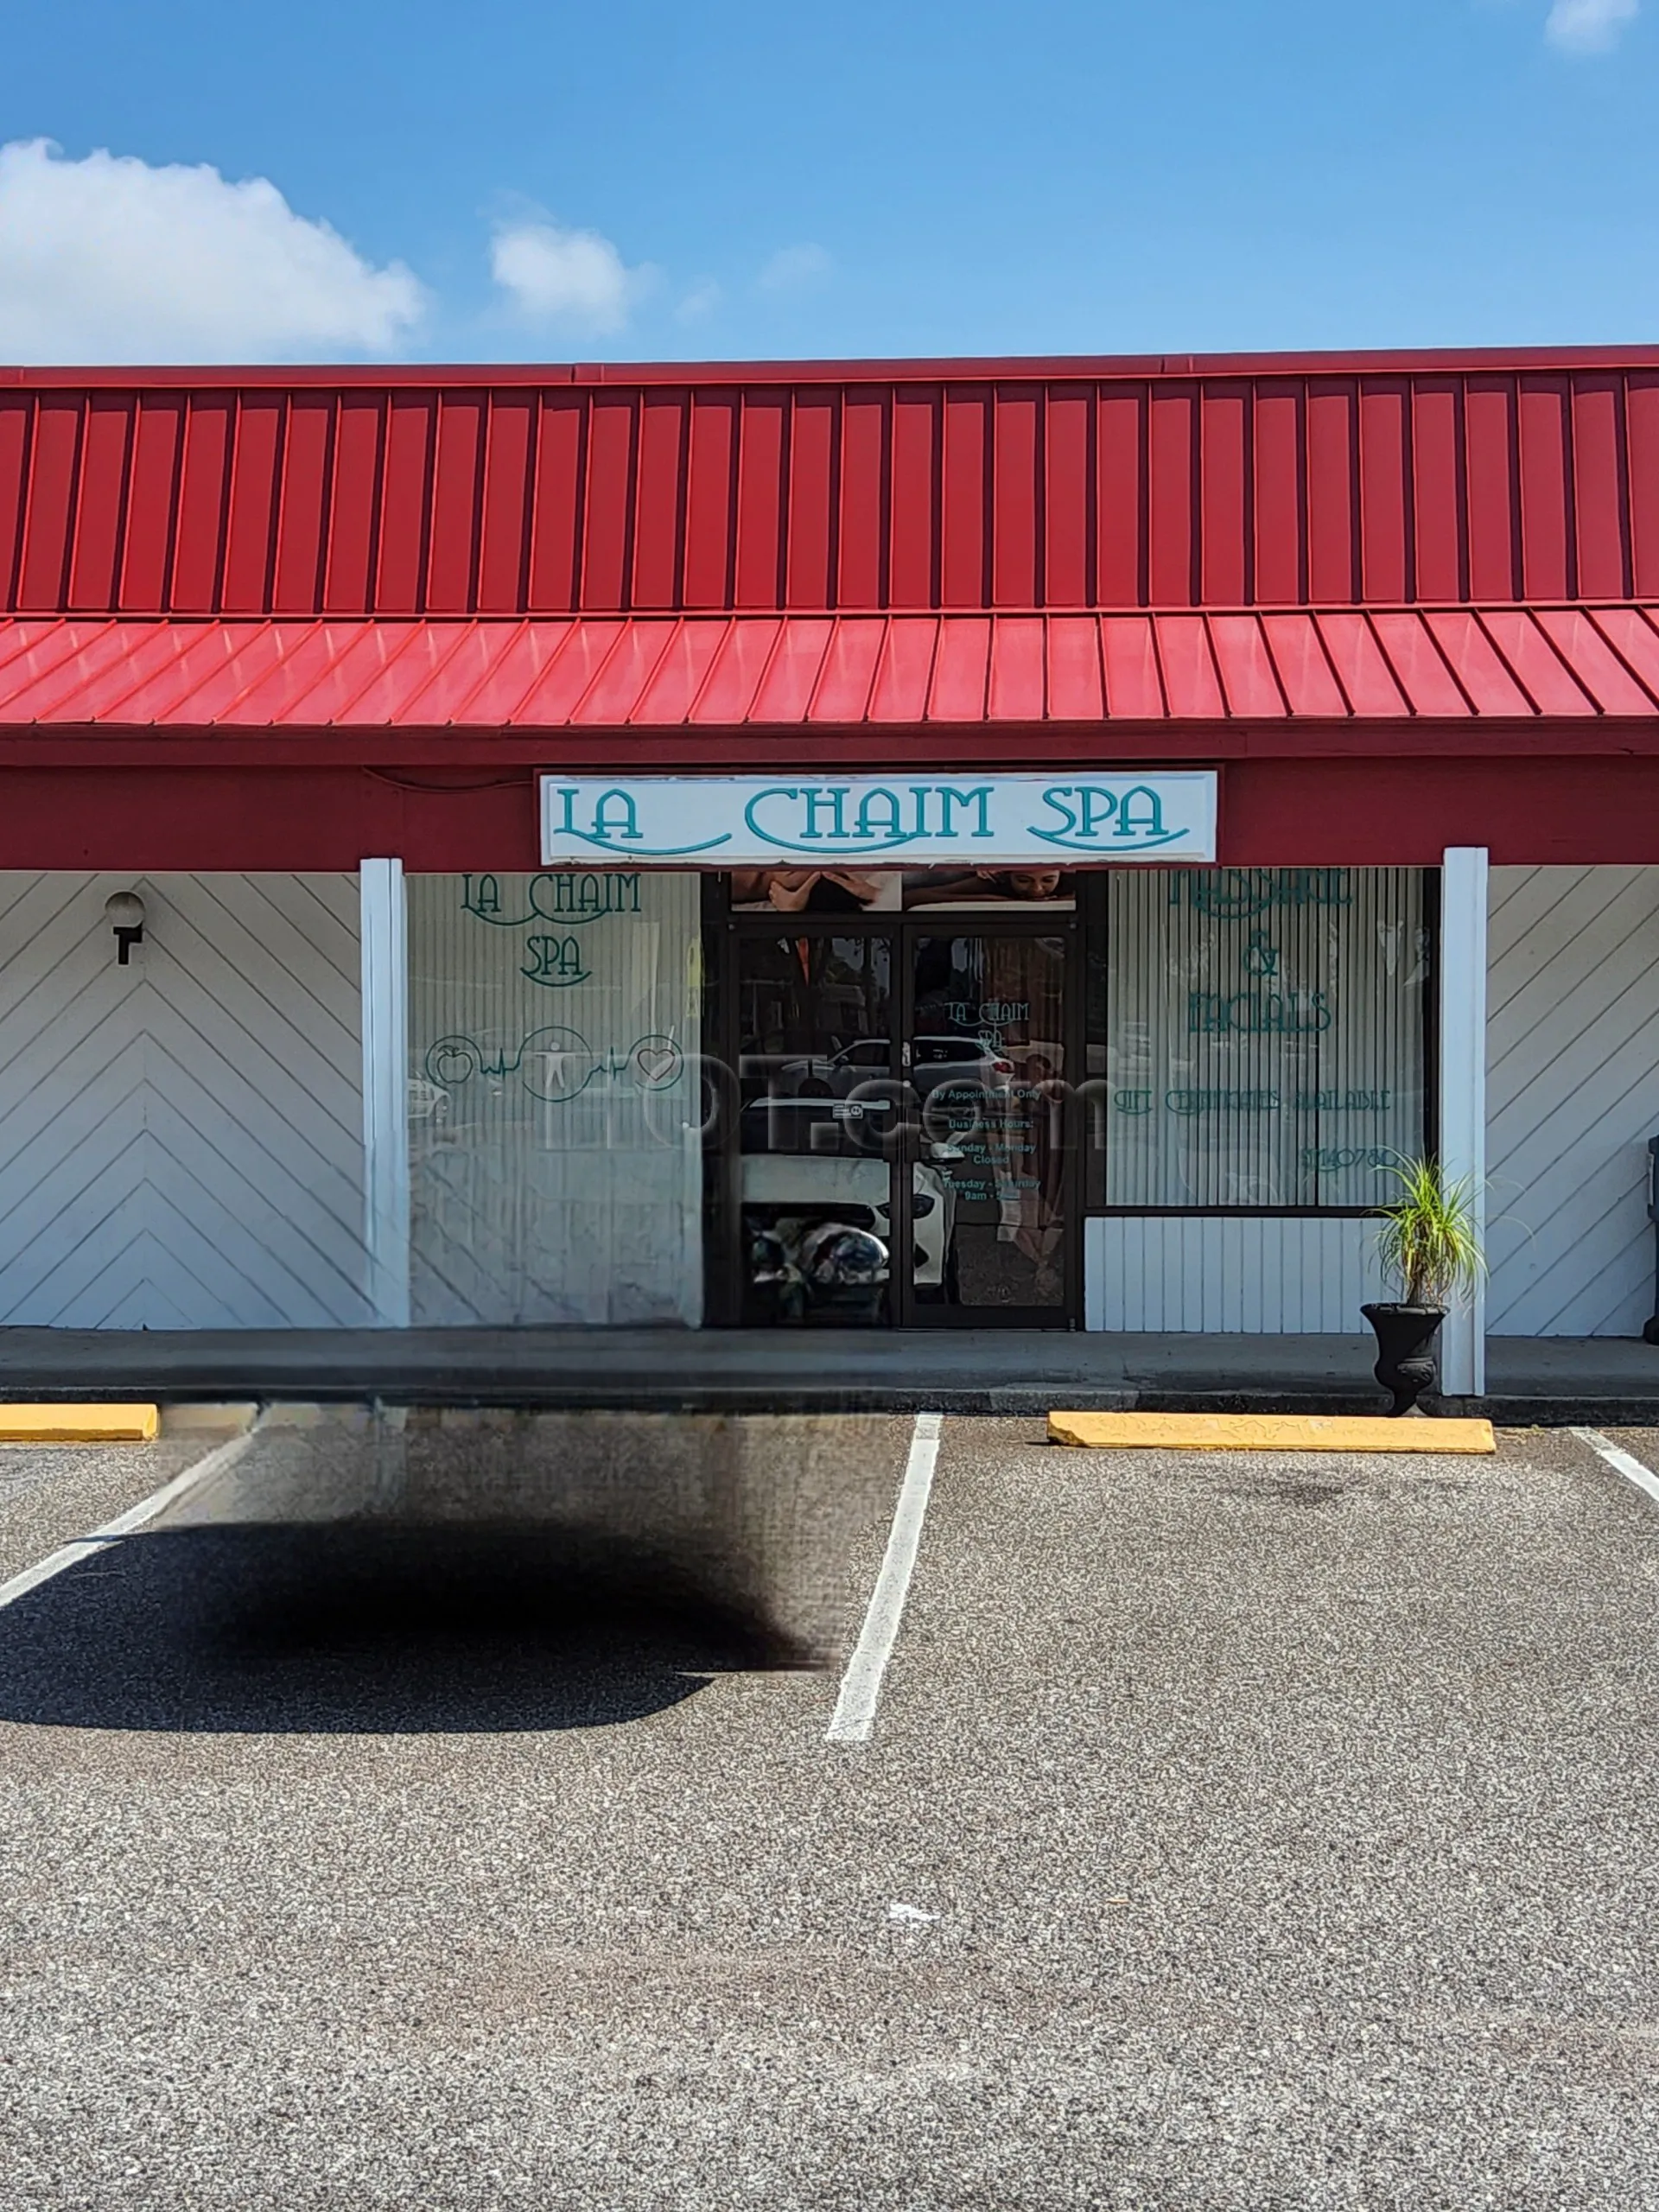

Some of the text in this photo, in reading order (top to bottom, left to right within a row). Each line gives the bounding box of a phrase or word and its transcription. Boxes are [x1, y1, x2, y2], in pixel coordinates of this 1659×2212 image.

[744, 785, 995, 853] CHAIM
[1027, 785, 1190, 851] SPA
[529, 873, 641, 925] CHAIM
[519, 935, 593, 987] SPA
[1242, 930, 1280, 976] &
[1188, 991, 1332, 1033] FACIALS
[932, 1089, 945, 1101] By
[1017, 1088, 1041, 1101] Only
[943, 1179, 986, 1190] Tuesday
[995, 1179, 1041, 1191] Srday
